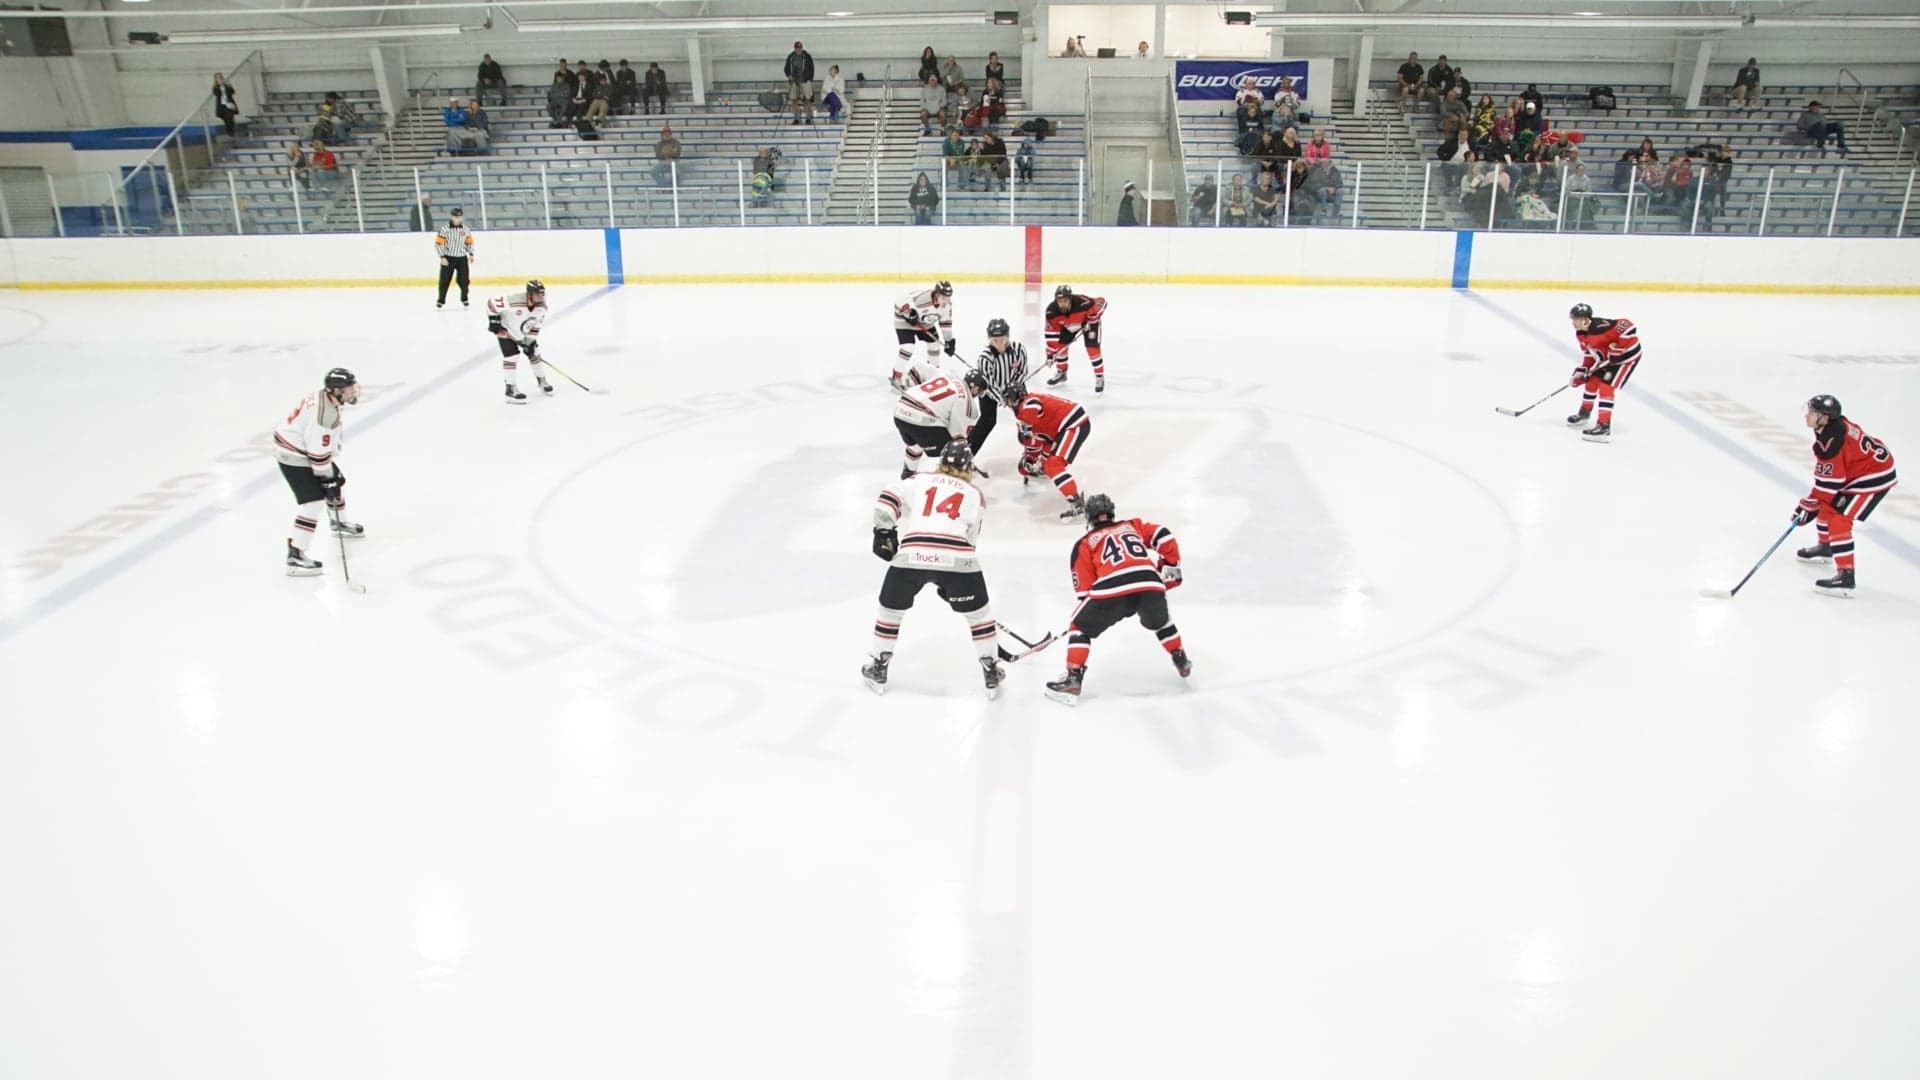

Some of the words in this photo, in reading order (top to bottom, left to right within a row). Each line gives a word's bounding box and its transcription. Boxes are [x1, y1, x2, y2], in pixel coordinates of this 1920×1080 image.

[1178, 74, 1228, 87] BUD
[920, 377, 957, 402] 81
[321, 434, 332, 447] 9
[1814, 462, 1834, 476] 32
[921, 486, 965, 521] 14
[1100, 532, 1149, 567] 46
